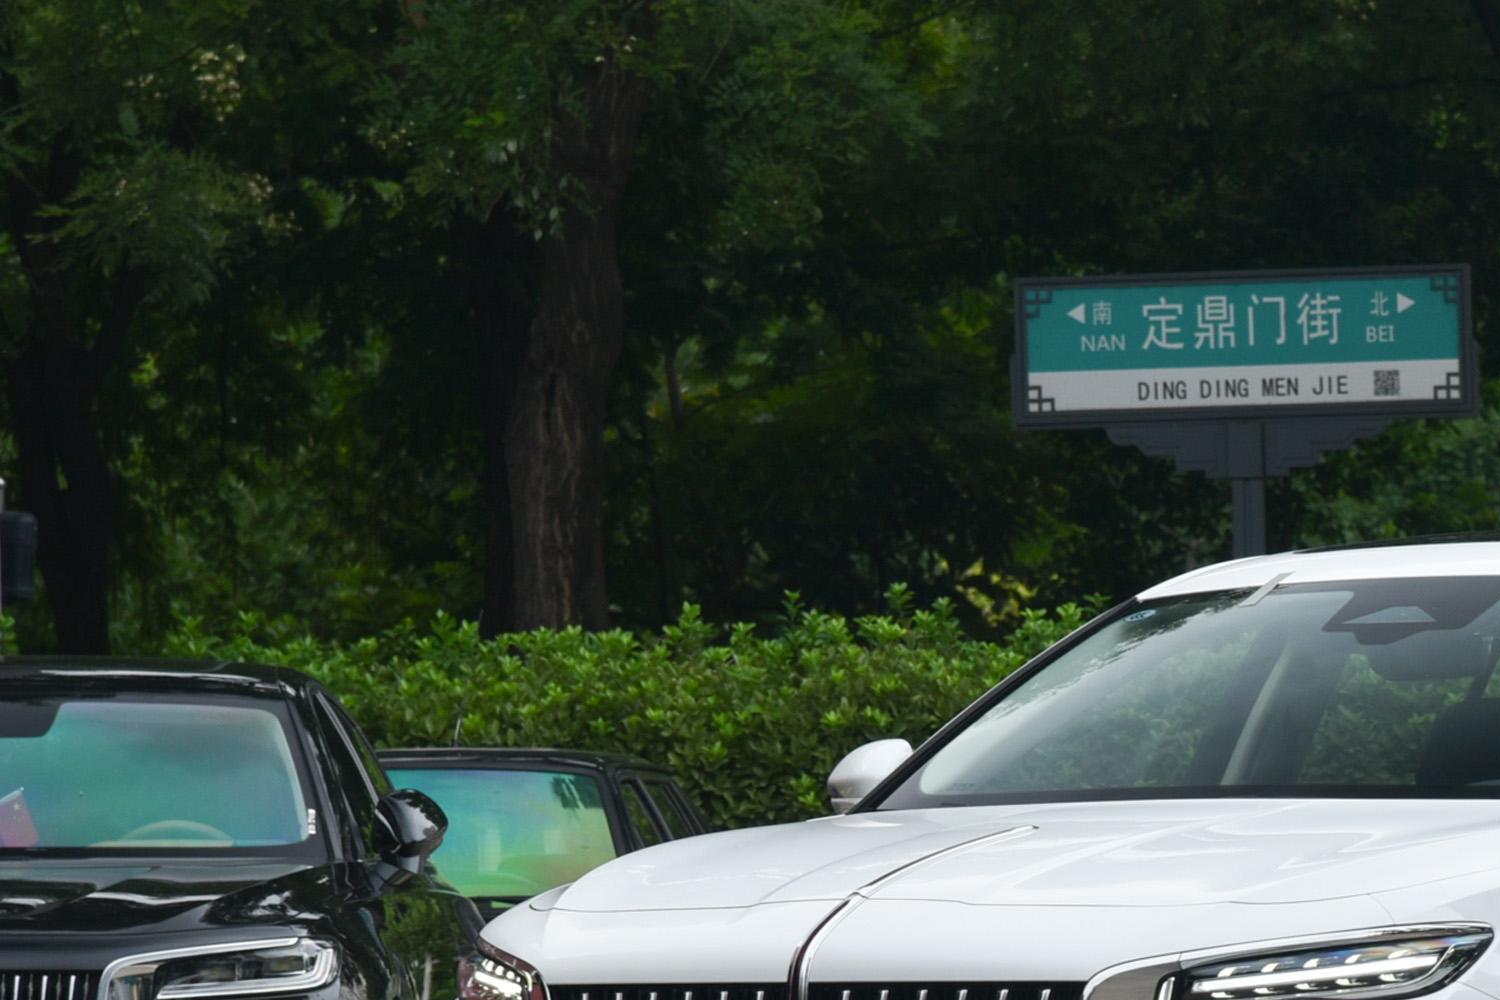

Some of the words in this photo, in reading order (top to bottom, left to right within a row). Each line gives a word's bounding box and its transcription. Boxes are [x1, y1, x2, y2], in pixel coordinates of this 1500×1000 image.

[1092, 300, 1112, 326] 南
[1369, 291, 1390, 317] 北
[1142, 292, 1342, 350] 定鼎门街
[1365, 325, 1396, 343] BEI
[1080, 333, 1126, 352] NAN
[1137, 380, 1187, 401] DING
[1200, 378, 1249, 399] DING
[1261, 377, 1299, 397] MEN
[1312, 375, 1349, 396] JIE
